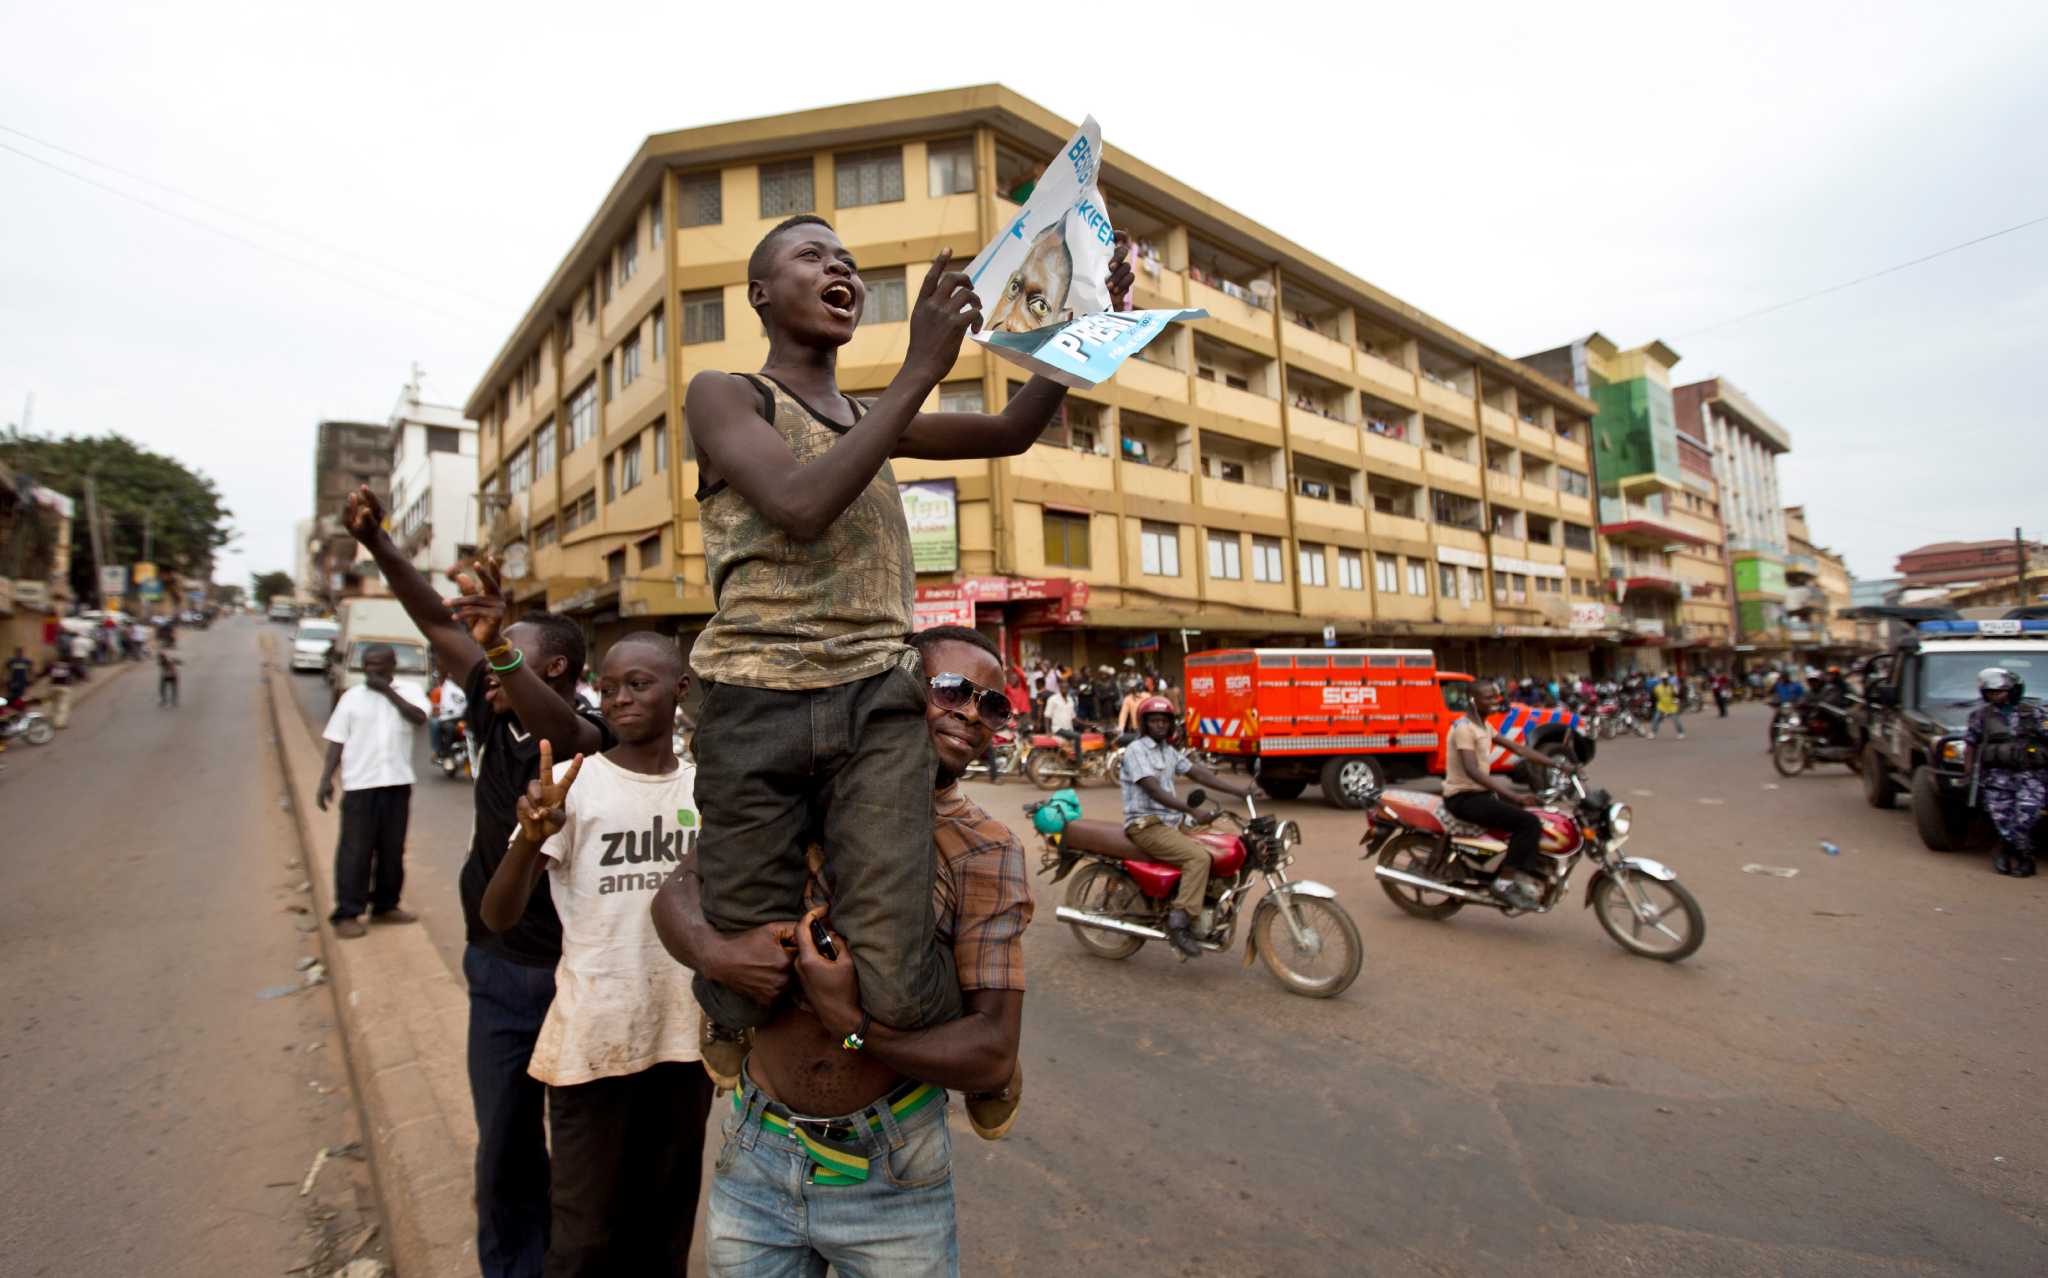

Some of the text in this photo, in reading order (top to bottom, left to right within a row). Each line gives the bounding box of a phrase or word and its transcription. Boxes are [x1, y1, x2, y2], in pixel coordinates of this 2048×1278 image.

[1225, 676, 1251, 690] SGA
[1322, 687, 1377, 704] SGA
[599, 815, 697, 867] zuku
